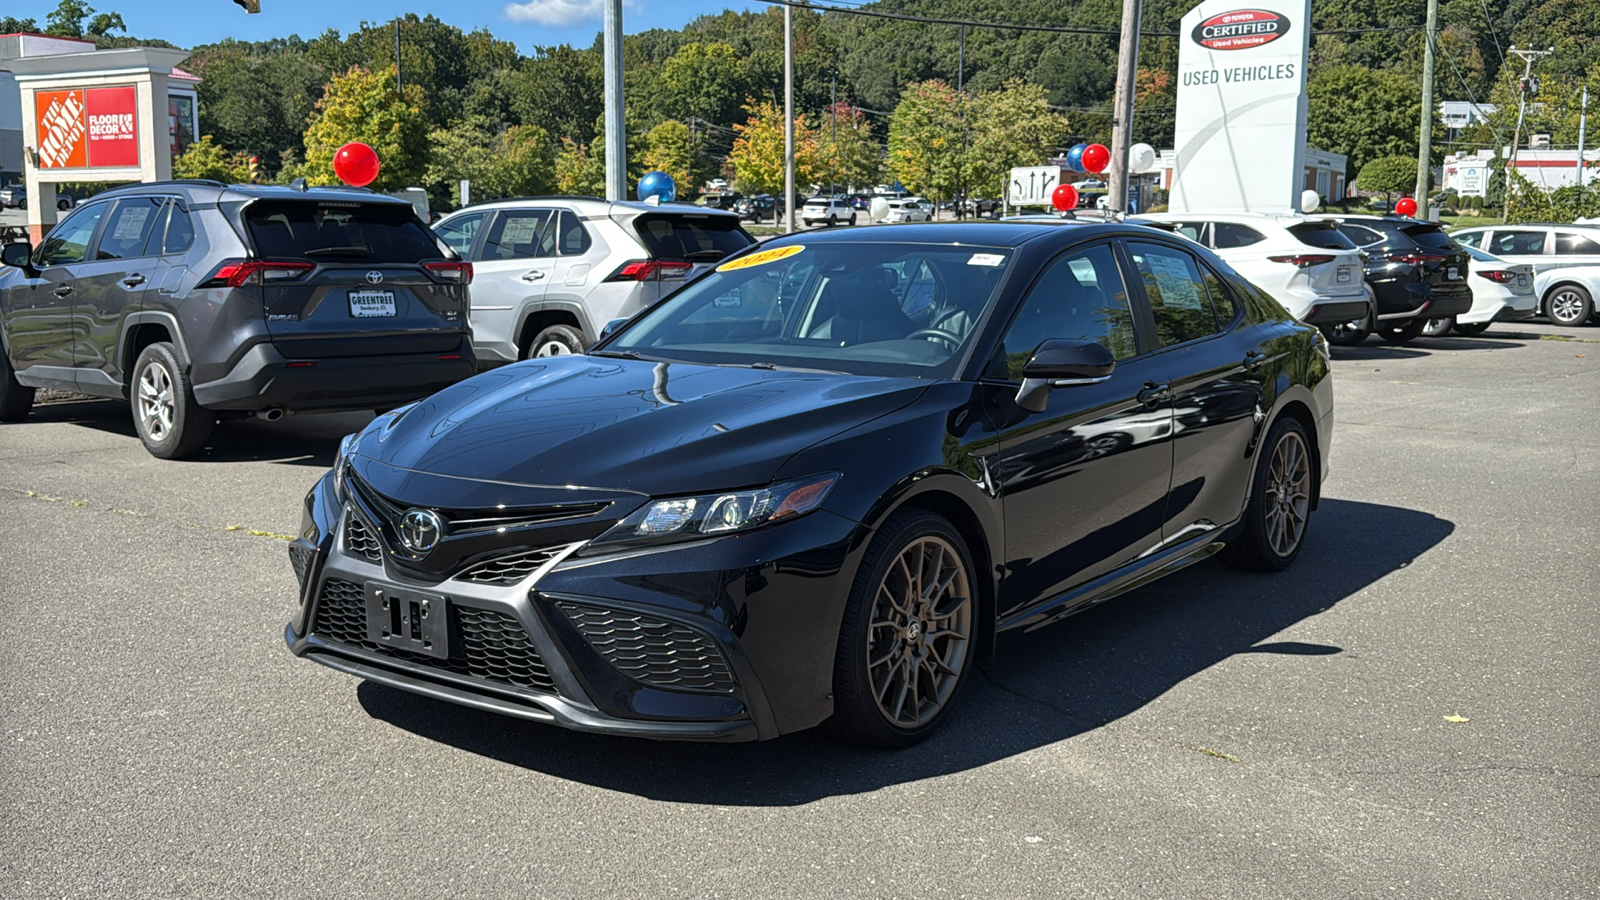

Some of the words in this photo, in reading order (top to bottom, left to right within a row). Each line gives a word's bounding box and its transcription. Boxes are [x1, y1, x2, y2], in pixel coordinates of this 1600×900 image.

[1202, 21, 1278, 38] CERTIFIED
[1213, 38, 1231, 48] Used
[1232, 36, 1265, 46] Vehicles
[1183, 69, 1219, 86] USED
[1224, 63, 1295, 83] VEHICLES
[41, 96, 62, 130] THE
[89, 113, 119, 125] FLOOR
[39, 91, 84, 168] HOME
[90, 124, 119, 135] DECOR
[56, 117, 85, 167] DEPOT
[351, 295, 393, 305] GREENTREE
